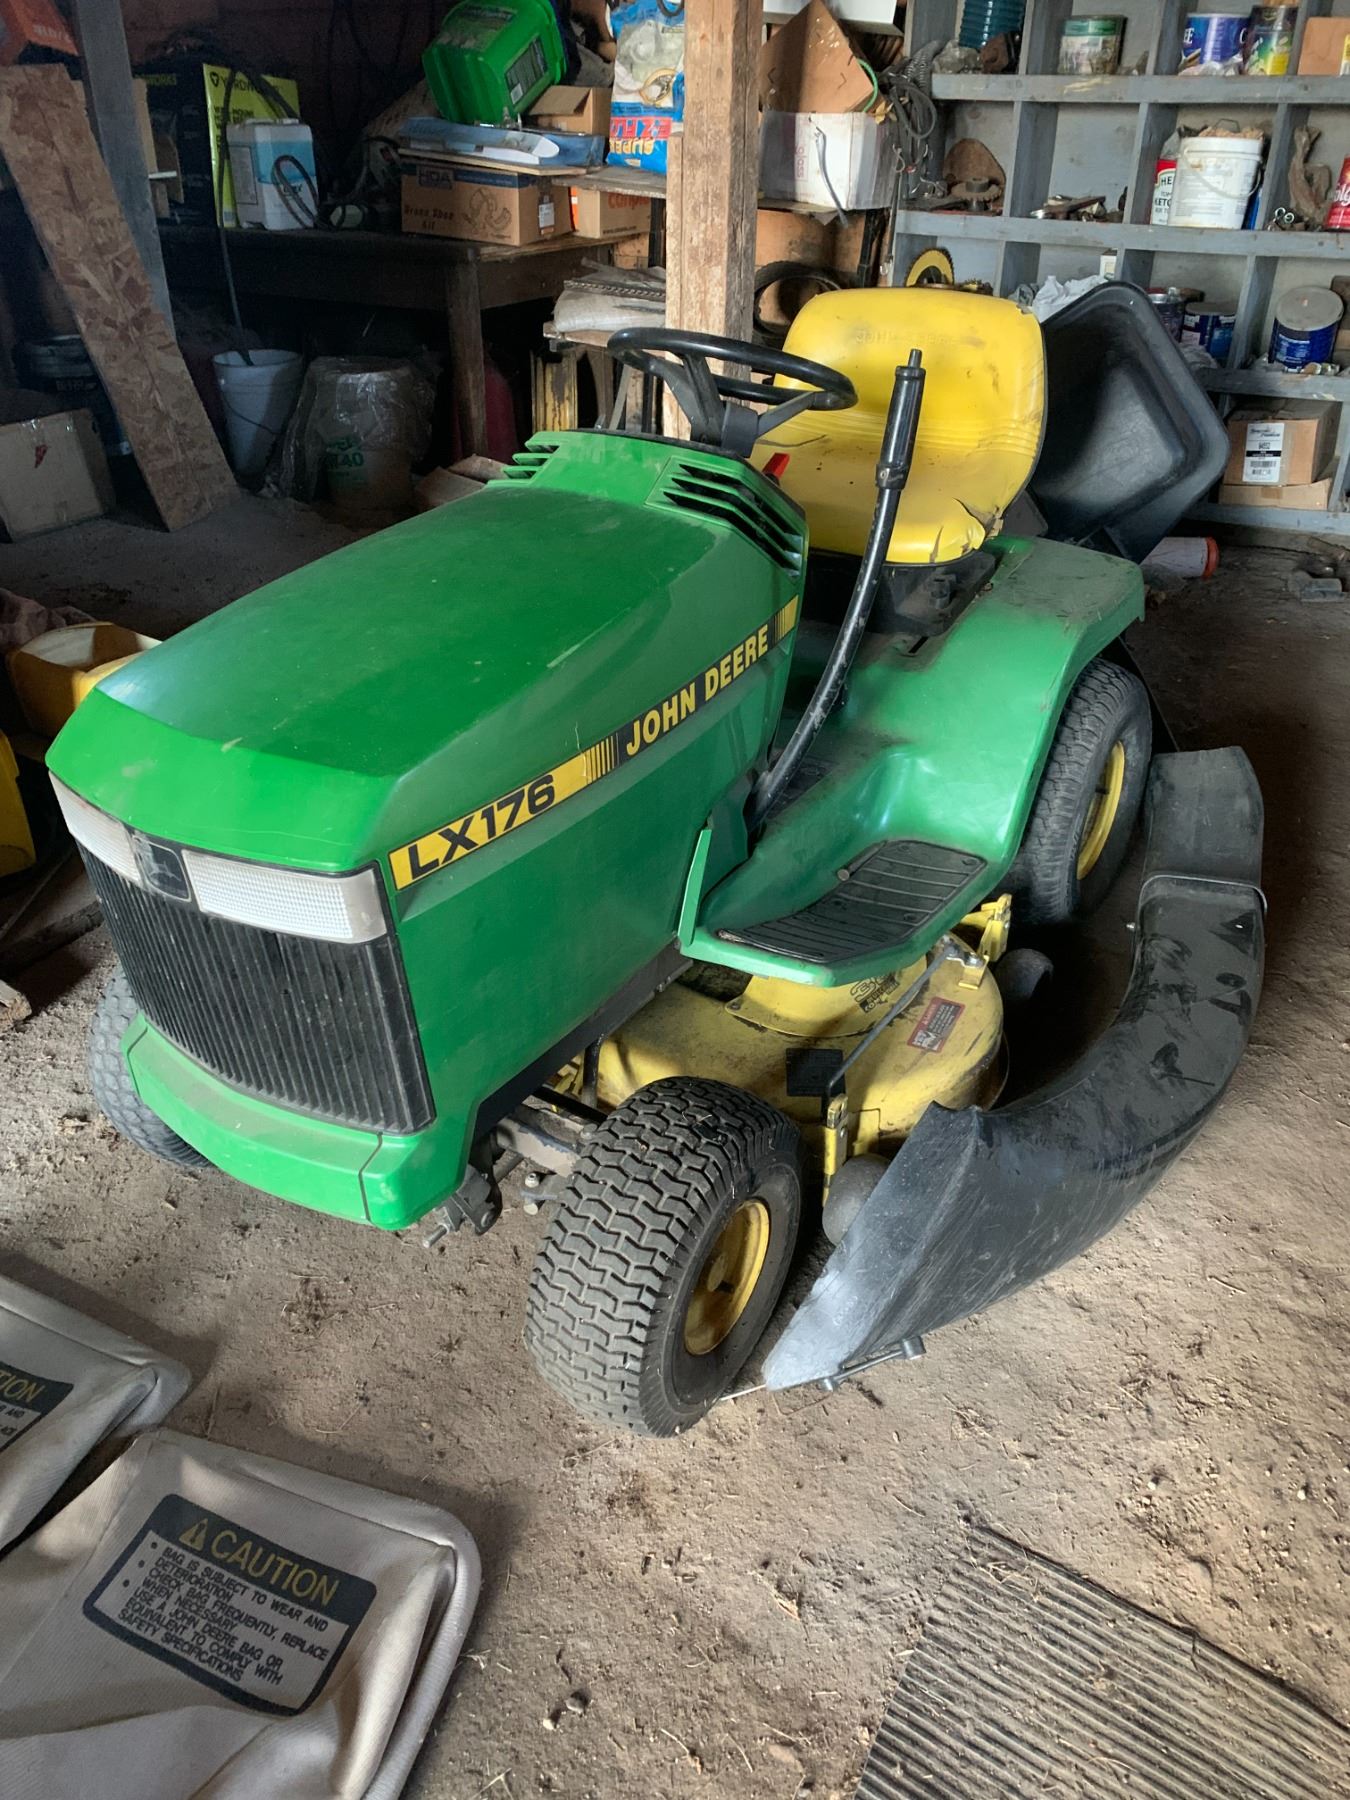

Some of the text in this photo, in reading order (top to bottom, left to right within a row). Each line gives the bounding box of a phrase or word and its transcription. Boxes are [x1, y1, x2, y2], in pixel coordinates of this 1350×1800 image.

[625, 624, 769, 757] JOHN DEERE
[408, 774, 555, 879] LX176
[142, 1577, 238, 1631] WHEN NECESSARY
[155, 1557, 234, 1602] DETERIORATION
[162, 1547, 328, 1632] BAG IS SUBJECT TO WEAR AND
[210, 1530, 340, 1606] CAUTION
[118, 1608, 244, 1682] SAFETY SPECIFICATIONS
[125, 1597, 284, 1686] EQUIVALENT TO COMPLY WITH
[134, 1587, 284, 1670] USE A JOHN DEERE BAG OR
[149, 1568, 329, 1661] CHECK BAG FREQUENTLY, REPLACE
